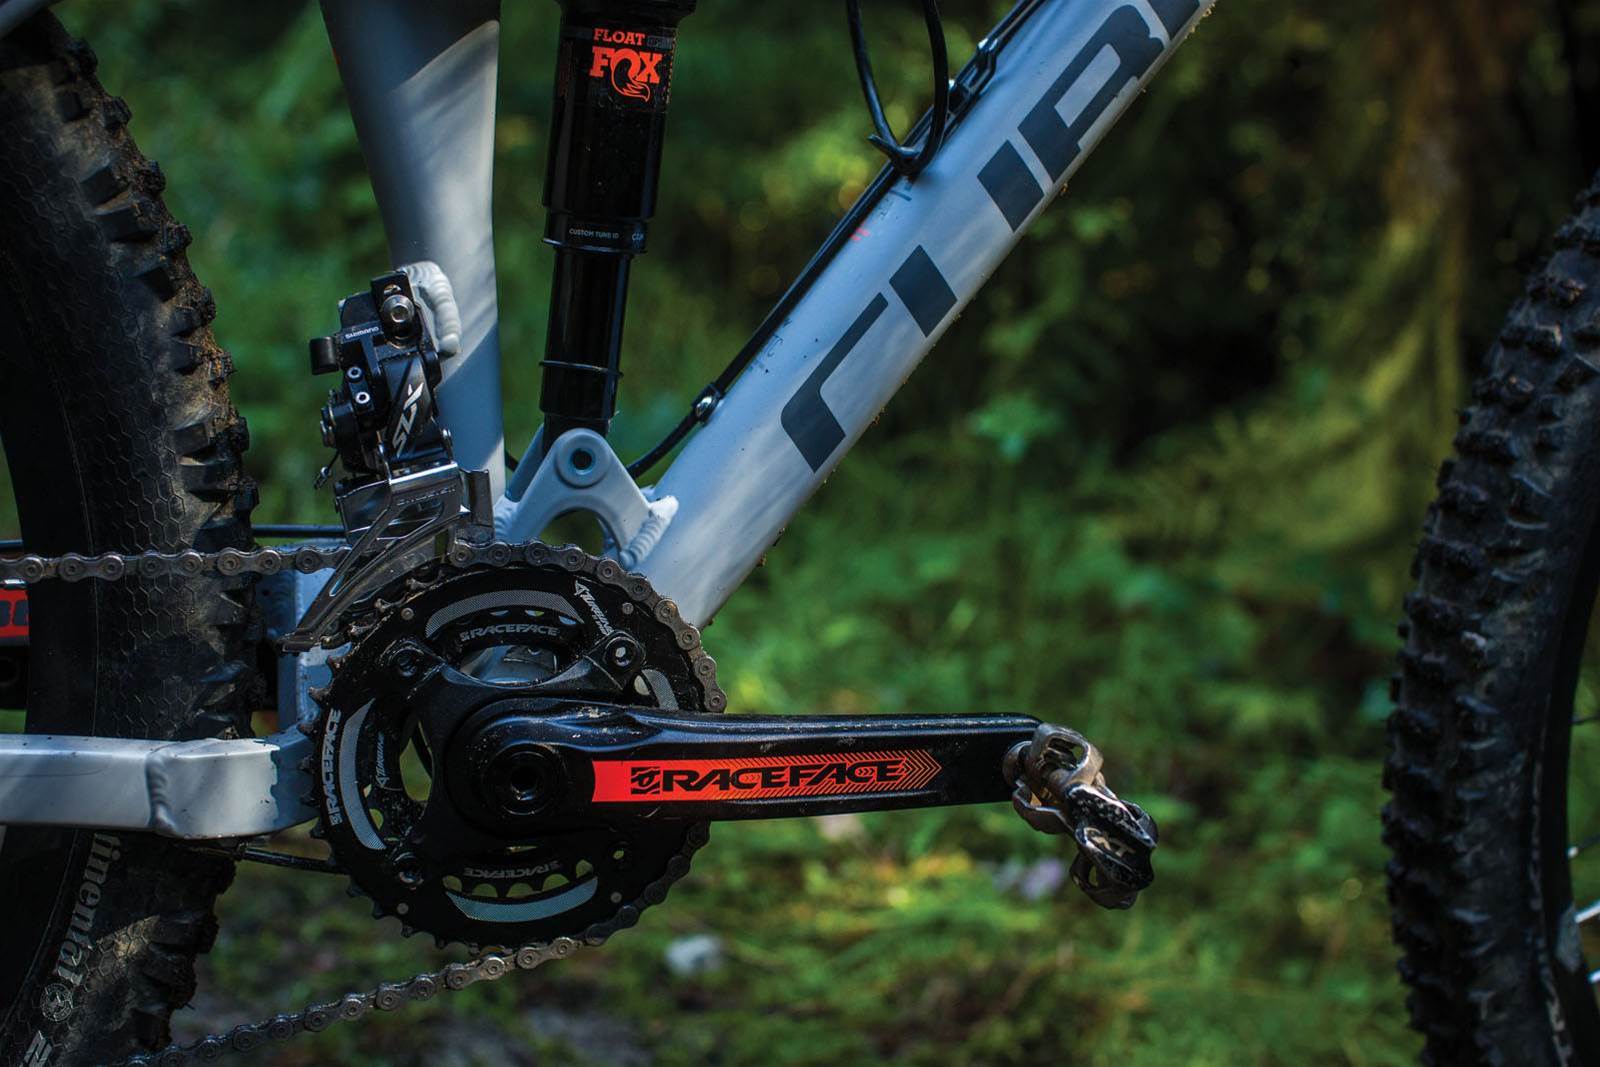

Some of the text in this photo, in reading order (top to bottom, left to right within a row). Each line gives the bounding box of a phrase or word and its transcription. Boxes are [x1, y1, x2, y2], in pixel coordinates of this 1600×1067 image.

[593, 27, 646, 46] FLOAT
[589, 46, 663, 102] FOX
[568, 227, 620, 239] CUSTOM TUNE ID
[344, 326, 379, 339] SHIMANO
[470, 623, 559, 640] RACEFACE
[320, 708, 341, 817] RACEFACE
[662, 759, 905, 792] RACEFACE
